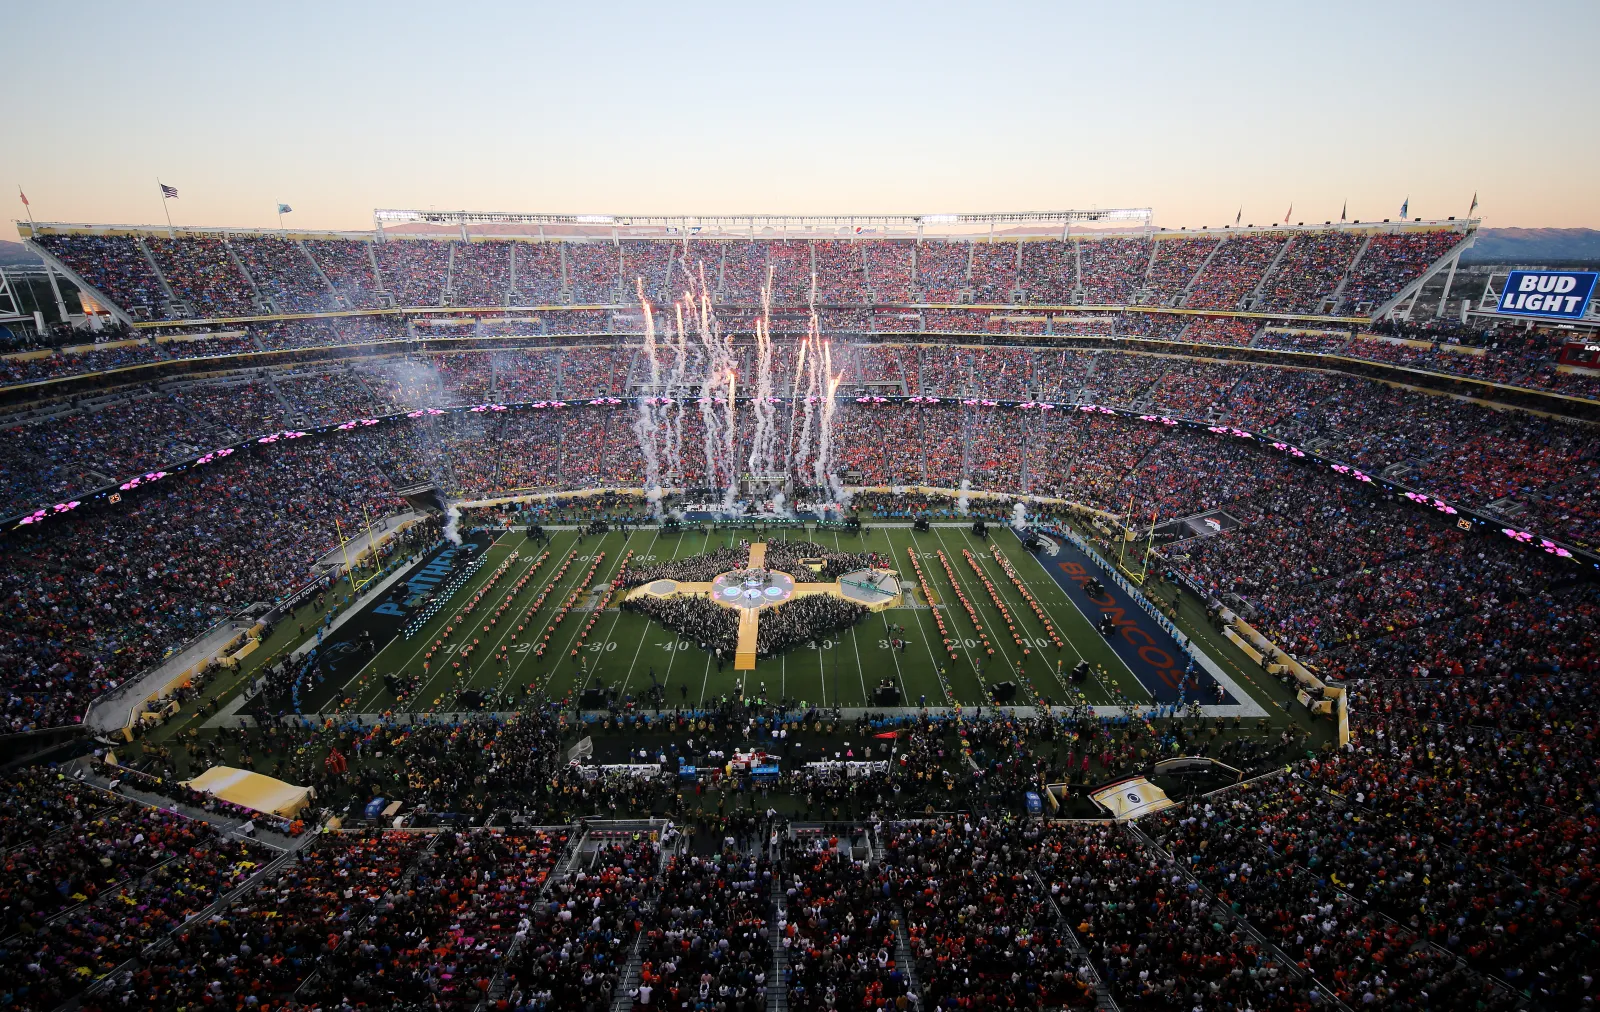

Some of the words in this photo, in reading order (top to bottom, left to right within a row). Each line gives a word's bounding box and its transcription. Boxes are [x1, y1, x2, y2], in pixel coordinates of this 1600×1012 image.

[186, 231, 224, 239] SUPER
[1250, 230, 1284, 238] SUPER
[1518, 275, 1577, 293] BUD
[1503, 293, 1582, 312] LIGHT
[1459, 519, 1470, 529] 25
[1169, 565, 1185, 582] SUPER
[1185, 579, 1200, 594] BOWL
[1200, 591, 1207, 599] 50
[280, 596, 301, 613] SUPER
[1058, 562, 1200, 692] BRONCOS
[444, 643, 472, 654] 10
[515, 642, 544, 653] 20
[589, 641, 618, 652] 30
[663, 641, 689, 651] 40
[806, 640, 833, 650] 40
[952, 639, 976, 649] 20
[1022, 638, 1048, 648] 10
